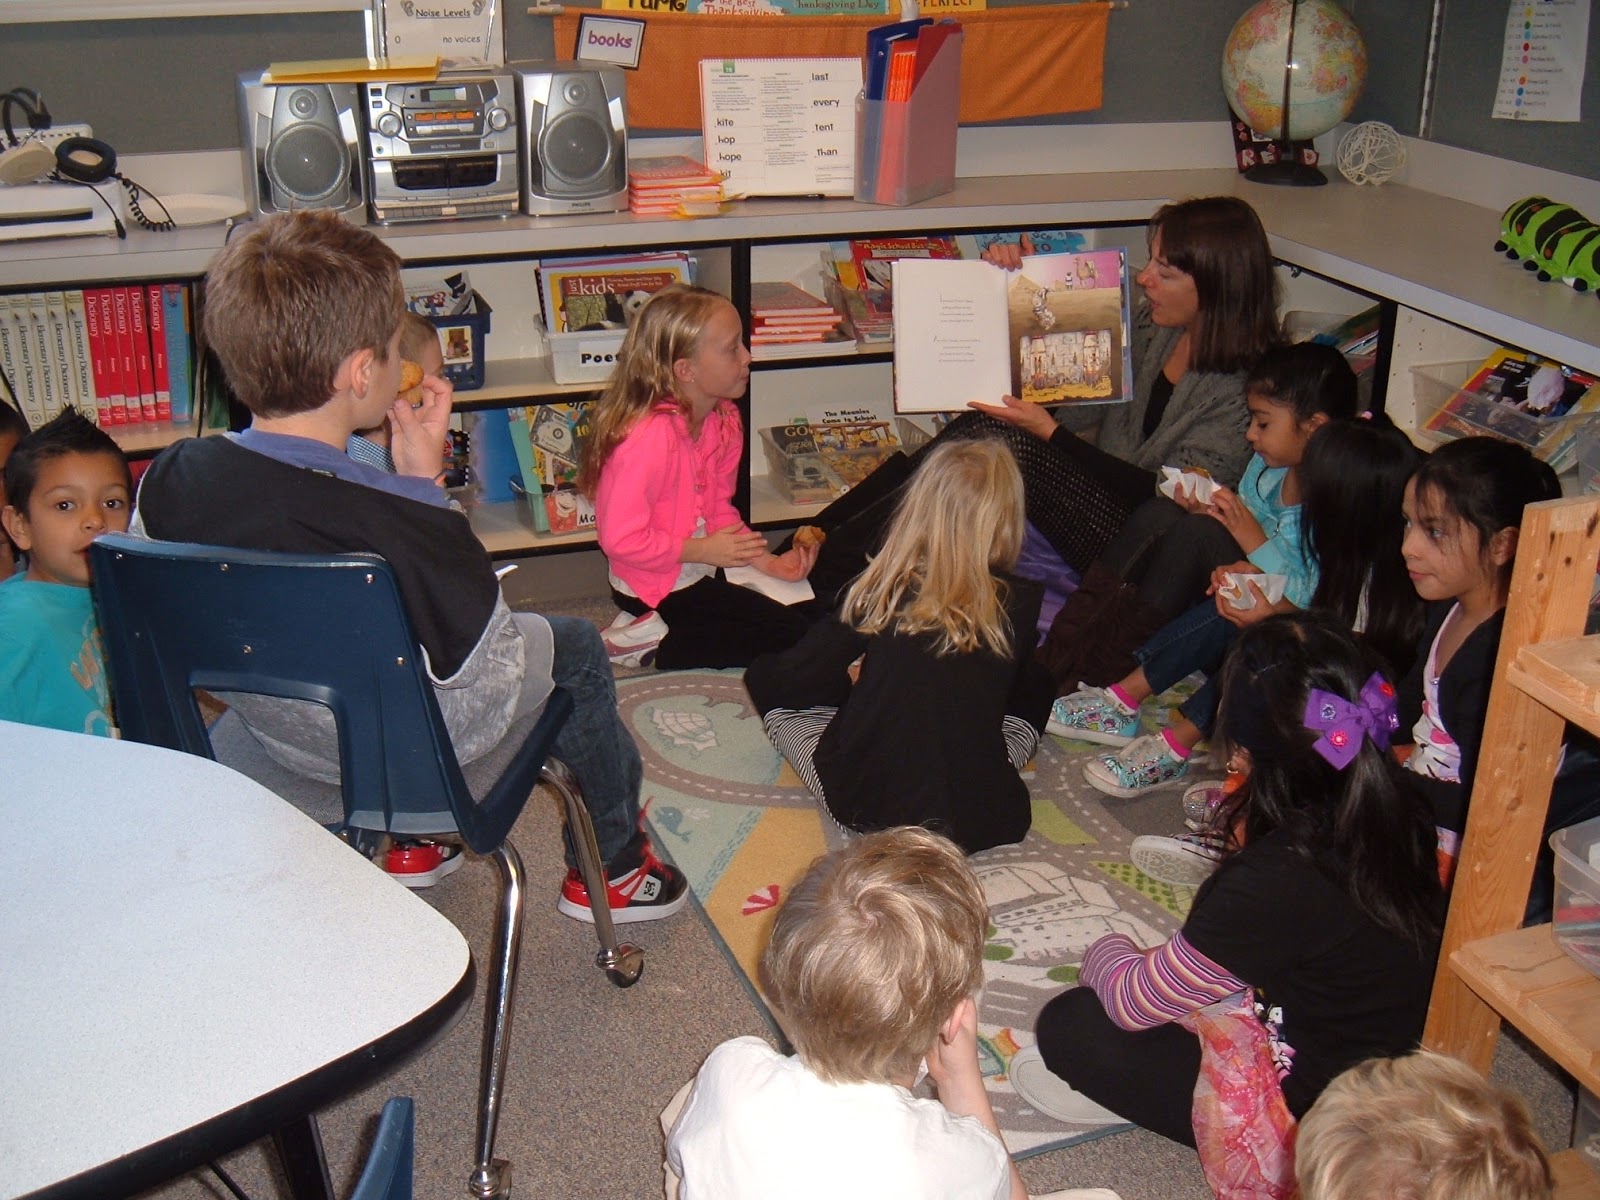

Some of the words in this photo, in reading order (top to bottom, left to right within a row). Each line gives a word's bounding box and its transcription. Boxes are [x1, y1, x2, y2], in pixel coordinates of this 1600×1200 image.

[415, 8, 440, 17] Noise
[443, 8, 471, 17] Levels
[797, 0, 856, 10] hanksgiving
[455, 35, 481, 43] voices
[588, 30, 633, 48] books
[811, 73, 829, 81] last
[813, 99, 840, 108] every
[716, 117, 734, 127] kite
[815, 123, 834, 131] tent
[718, 135, 735, 145] hop
[719, 152, 742, 163] hope
[816, 148, 838, 156] than
[720, 169, 732, 178] kit
[579, 277, 615, 296] kids
[87, 296, 100, 338] Dictionary
[101, 294, 114, 336] Dictionary
[116, 293, 128, 335] Dictionary
[131, 291, 144, 334] Dictionary
[151, 289, 162, 332] Dictionary
[1, 327, 13, 367] Elementary
[74, 320, 85, 360] Elementary
[19, 325, 30, 365] Elementary
[25, 366, 37, 403] Dictionary
[37, 324, 48, 364] Elementary
[43, 365, 54, 402] Dictionary
[55, 322, 66, 362] Elementary
[61, 363, 71, 400] Dictionary
[79, 361, 89, 398] Dictionary
